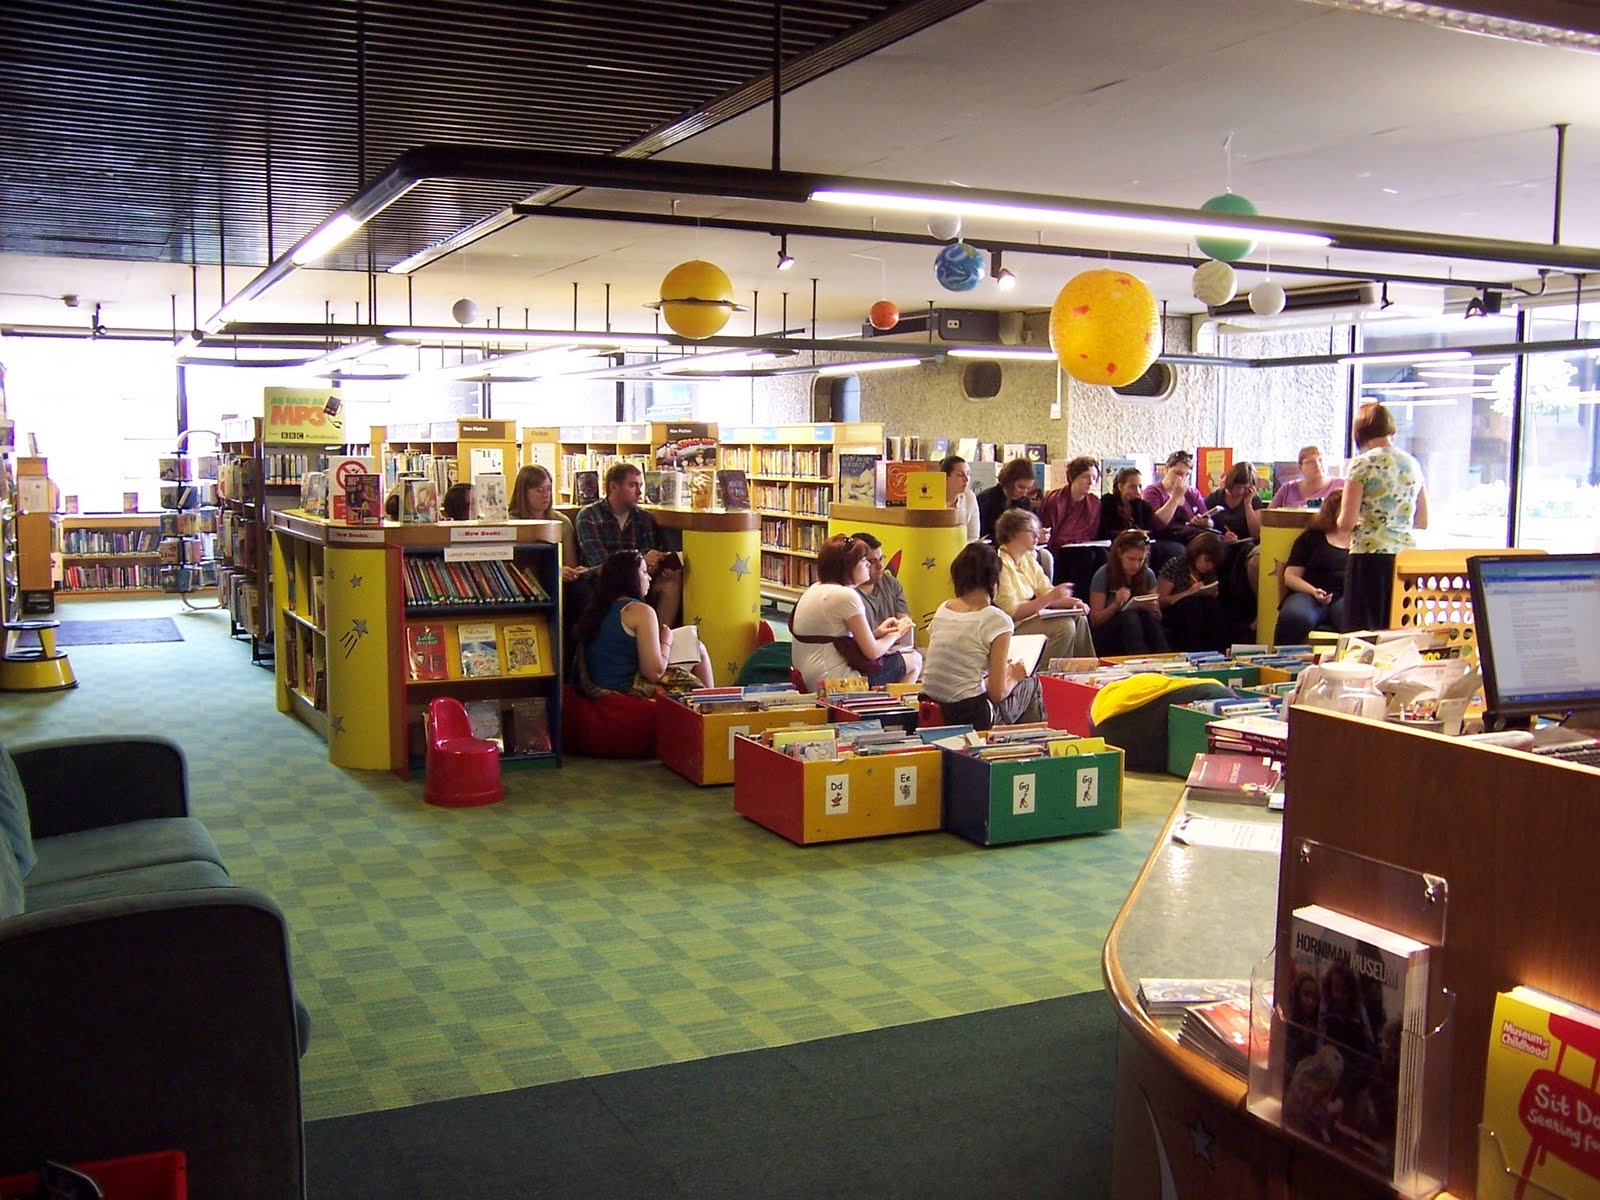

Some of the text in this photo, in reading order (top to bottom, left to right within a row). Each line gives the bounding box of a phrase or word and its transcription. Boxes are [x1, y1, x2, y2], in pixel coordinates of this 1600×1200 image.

[271, 405, 326, 427] MP3
[831, 781, 843, 791] Dd
[900, 773, 911, 783] Ee
[1019, 781, 1030, 792] Gg
[1082, 775, 1093, 786] Gg
[1296, 931, 1399, 991] HORNIMAN MUSEUM
[1502, 1021, 1543, 1046] Museum
[1501, 1033, 1549, 1060] Childhood
[1534, 1083, 1571, 1117] Sit
[1527, 1109, 1582, 1148] Seating
